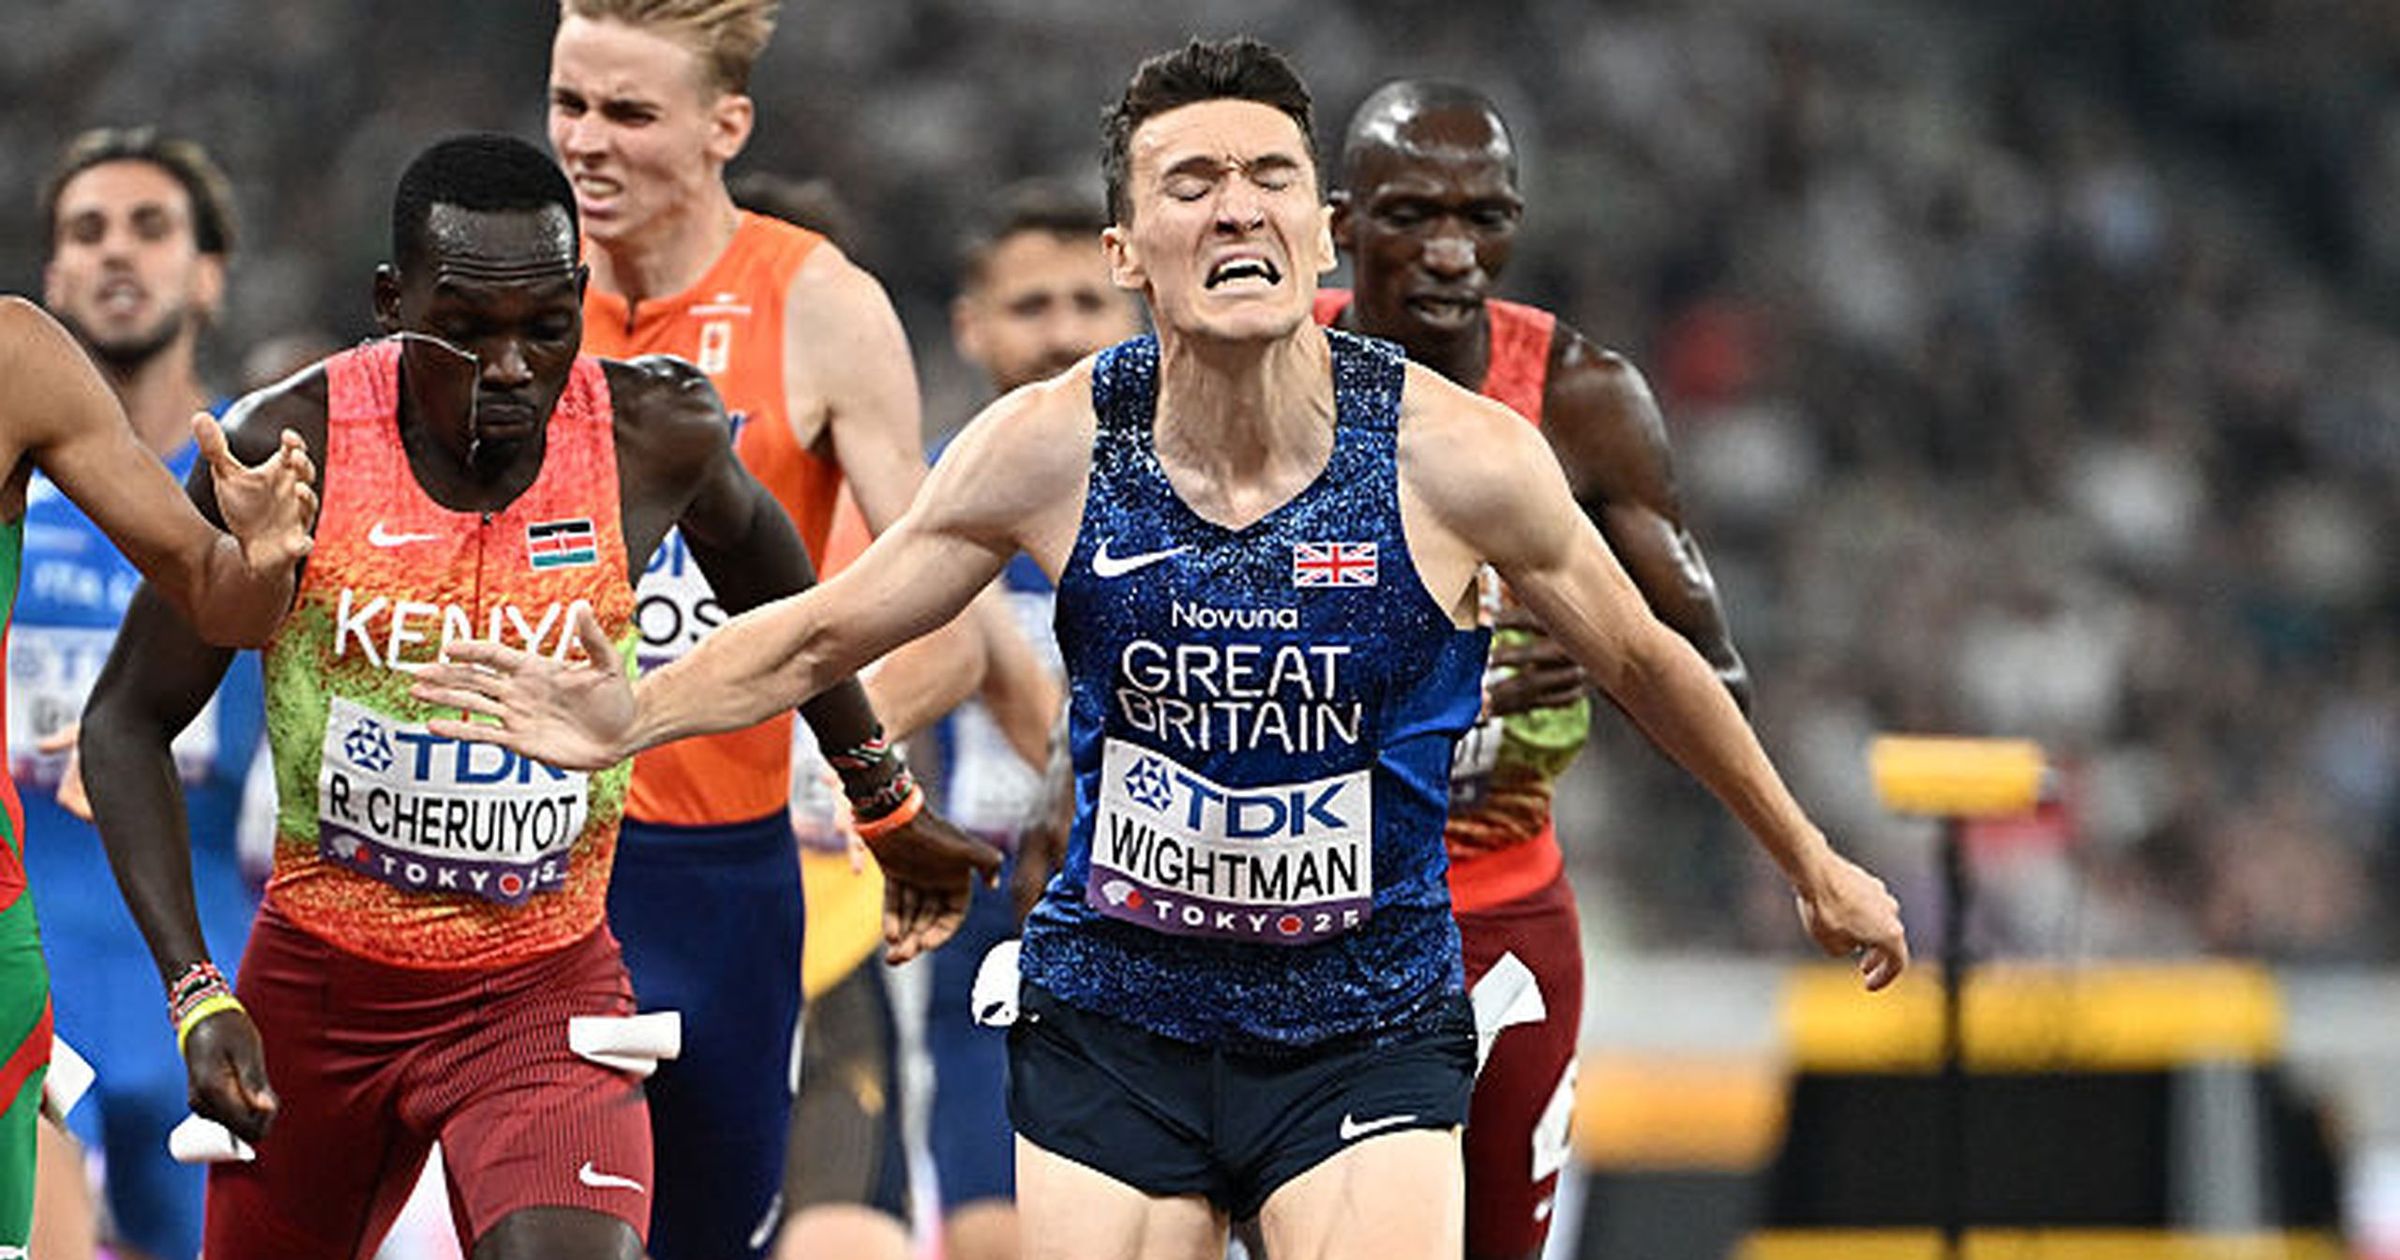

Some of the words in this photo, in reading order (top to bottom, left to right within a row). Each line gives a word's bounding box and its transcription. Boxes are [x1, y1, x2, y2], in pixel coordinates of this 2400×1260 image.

[333, 588, 593, 676] KENYA
[1171, 600, 1299, 629] Novuna
[1121, 639, 1352, 700] GREAT
[1116, 687, 1363, 754] BRITAIN
[330, 773, 360, 824] R.
[367, 786, 578, 853] CHERUIYOT
[1174, 770, 1349, 840] TDK
[1110, 812, 1358, 901] WIGHTMAN
